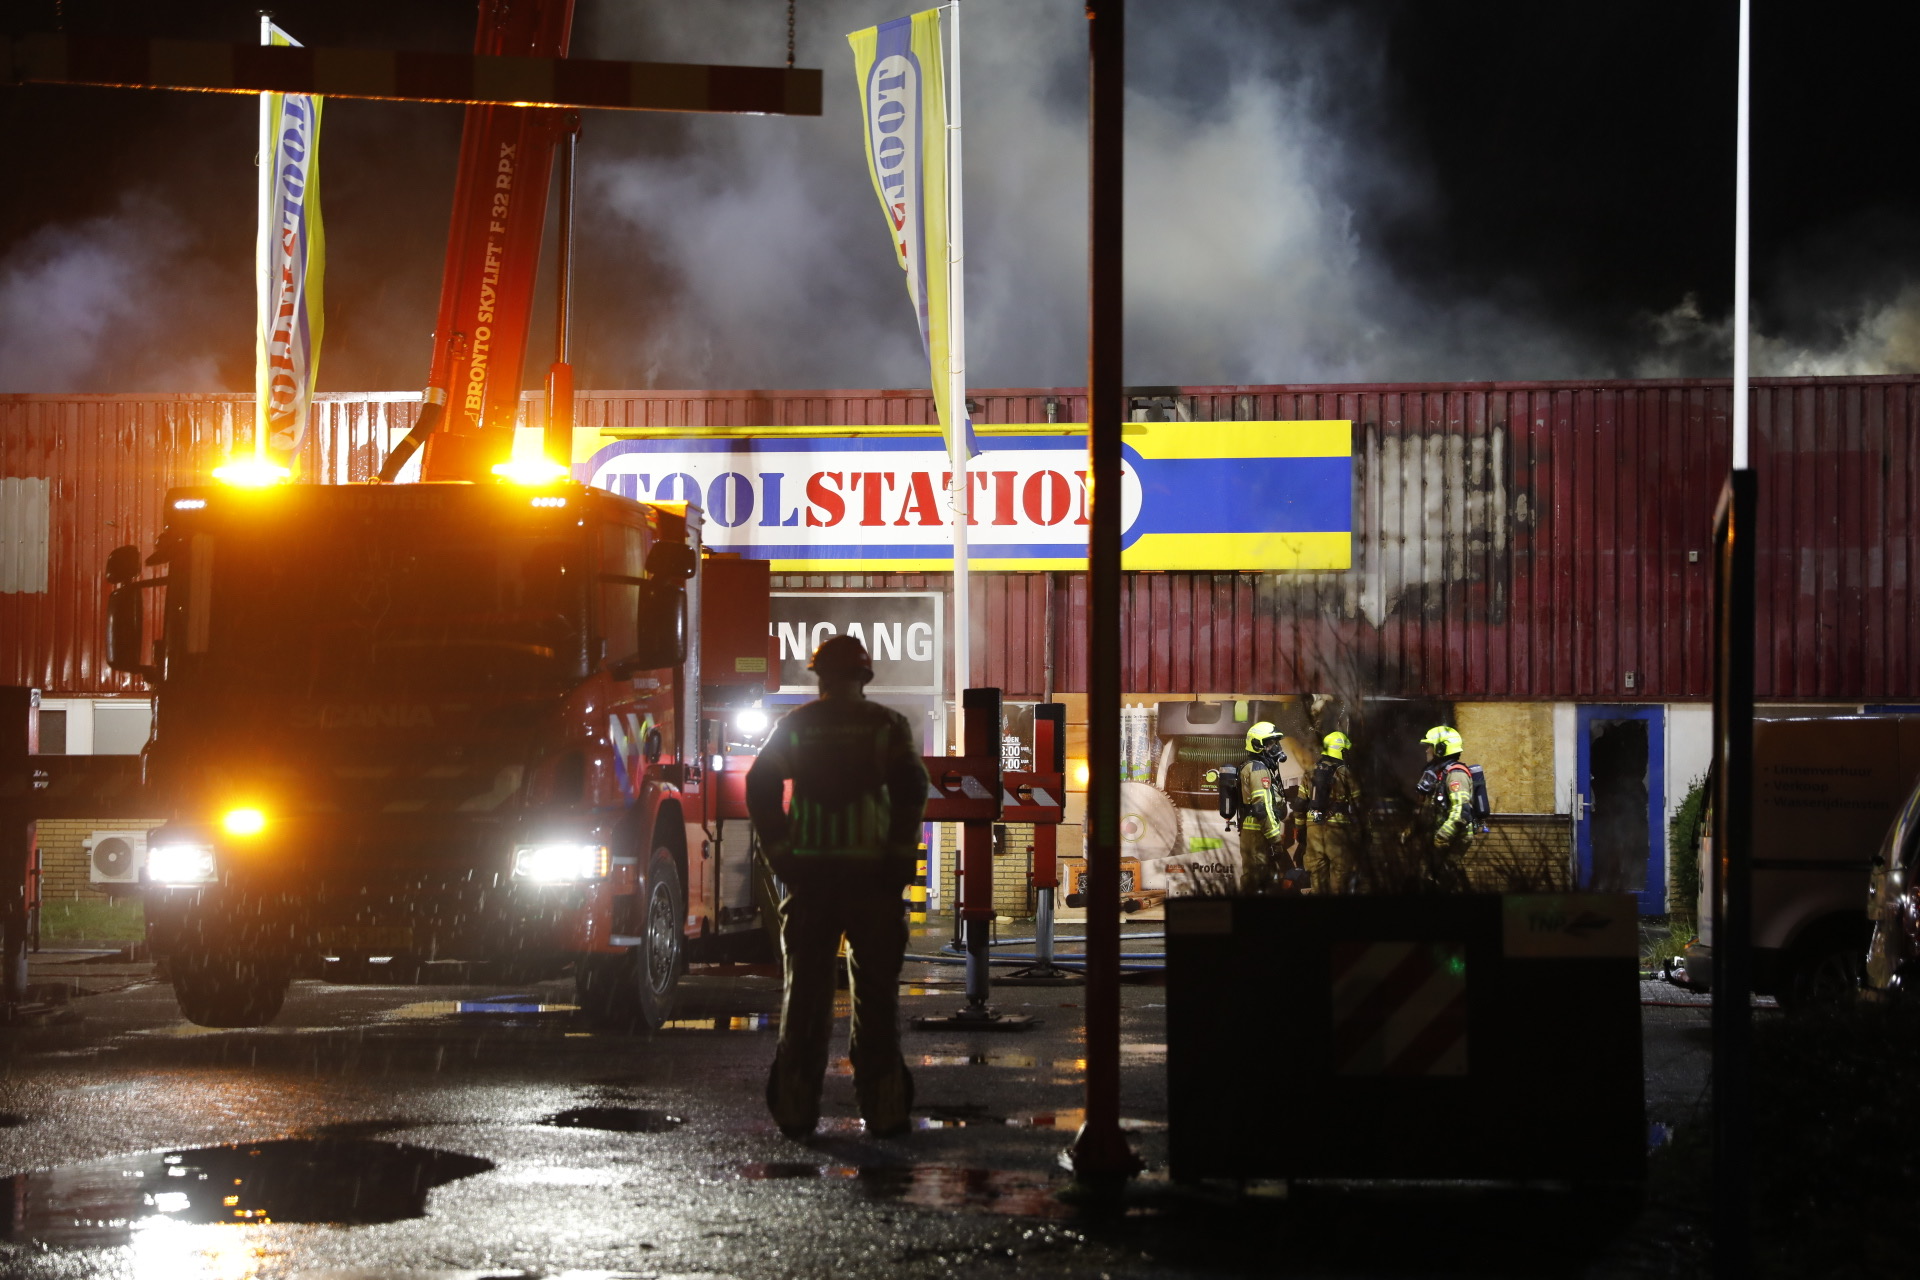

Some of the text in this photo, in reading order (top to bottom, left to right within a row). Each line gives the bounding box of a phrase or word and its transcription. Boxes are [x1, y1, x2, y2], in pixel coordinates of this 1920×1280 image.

[496, 142, 516, 189] RPX
[492, 193, 509, 219] 32
[490, 221, 505, 233] F
[465, 326, 491, 410] BRONTO
[606, 470, 1125, 527] TOOLSTATIO
[769, 621, 932, 661] NGANG
[1774, 765, 1872, 777] Linnenverhuur
[1774, 781, 1829, 793] Verkoop
[1774, 798, 1889, 812] Wasserijdiensten
[1192, 863, 1234, 873] ProfCut
